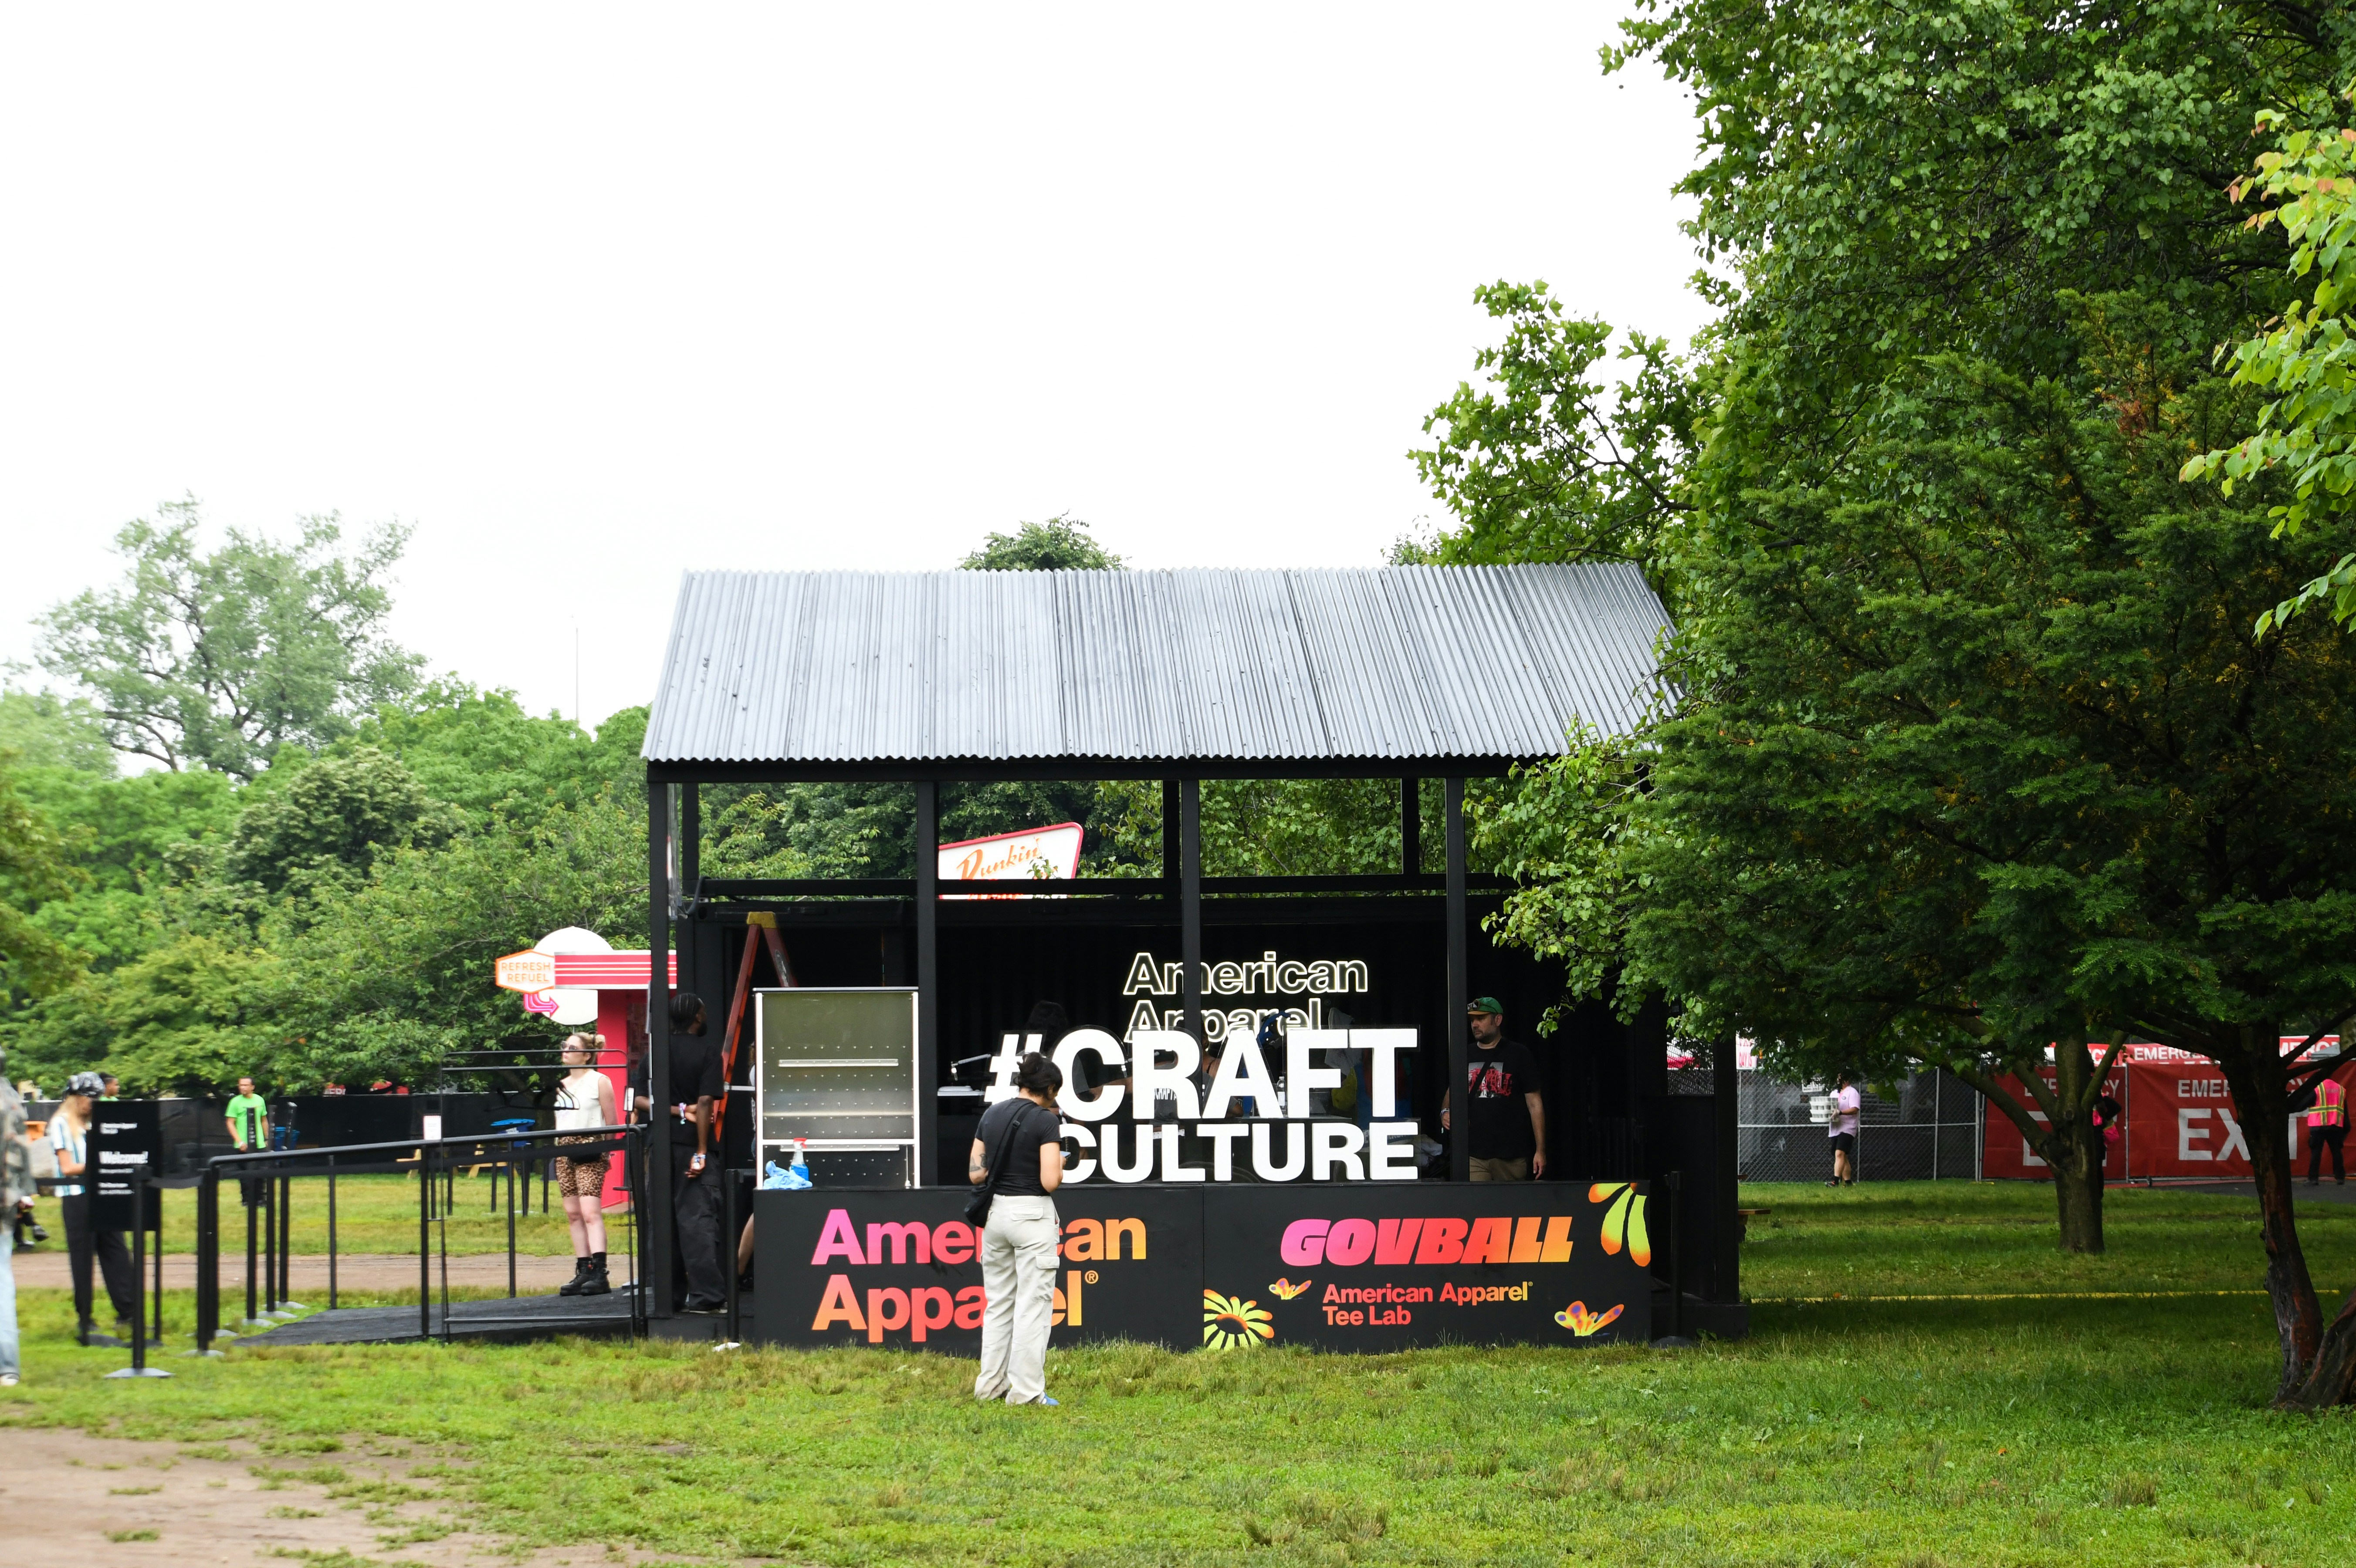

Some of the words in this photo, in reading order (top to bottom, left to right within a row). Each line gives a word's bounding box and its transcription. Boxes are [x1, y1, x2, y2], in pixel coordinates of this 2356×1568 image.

[501, 962, 551, 971] REFRESH
[508, 973, 549, 982] REFUEL
[984, 1028, 1418, 1121] #CRAFT
[2178, 1108, 2309, 1161] EXT
[99, 1151, 149, 1164] Welcome!
[1059, 1122, 1418, 1183] CULTURE
[811, 1209, 1147, 1265] Amean
[1280, 1217, 1574, 1266] GOVBALL
[1323, 1284, 1433, 1303] American
[1322, 1306, 1364, 1325] Tee
[1369, 1305, 1411, 1325] Lab
